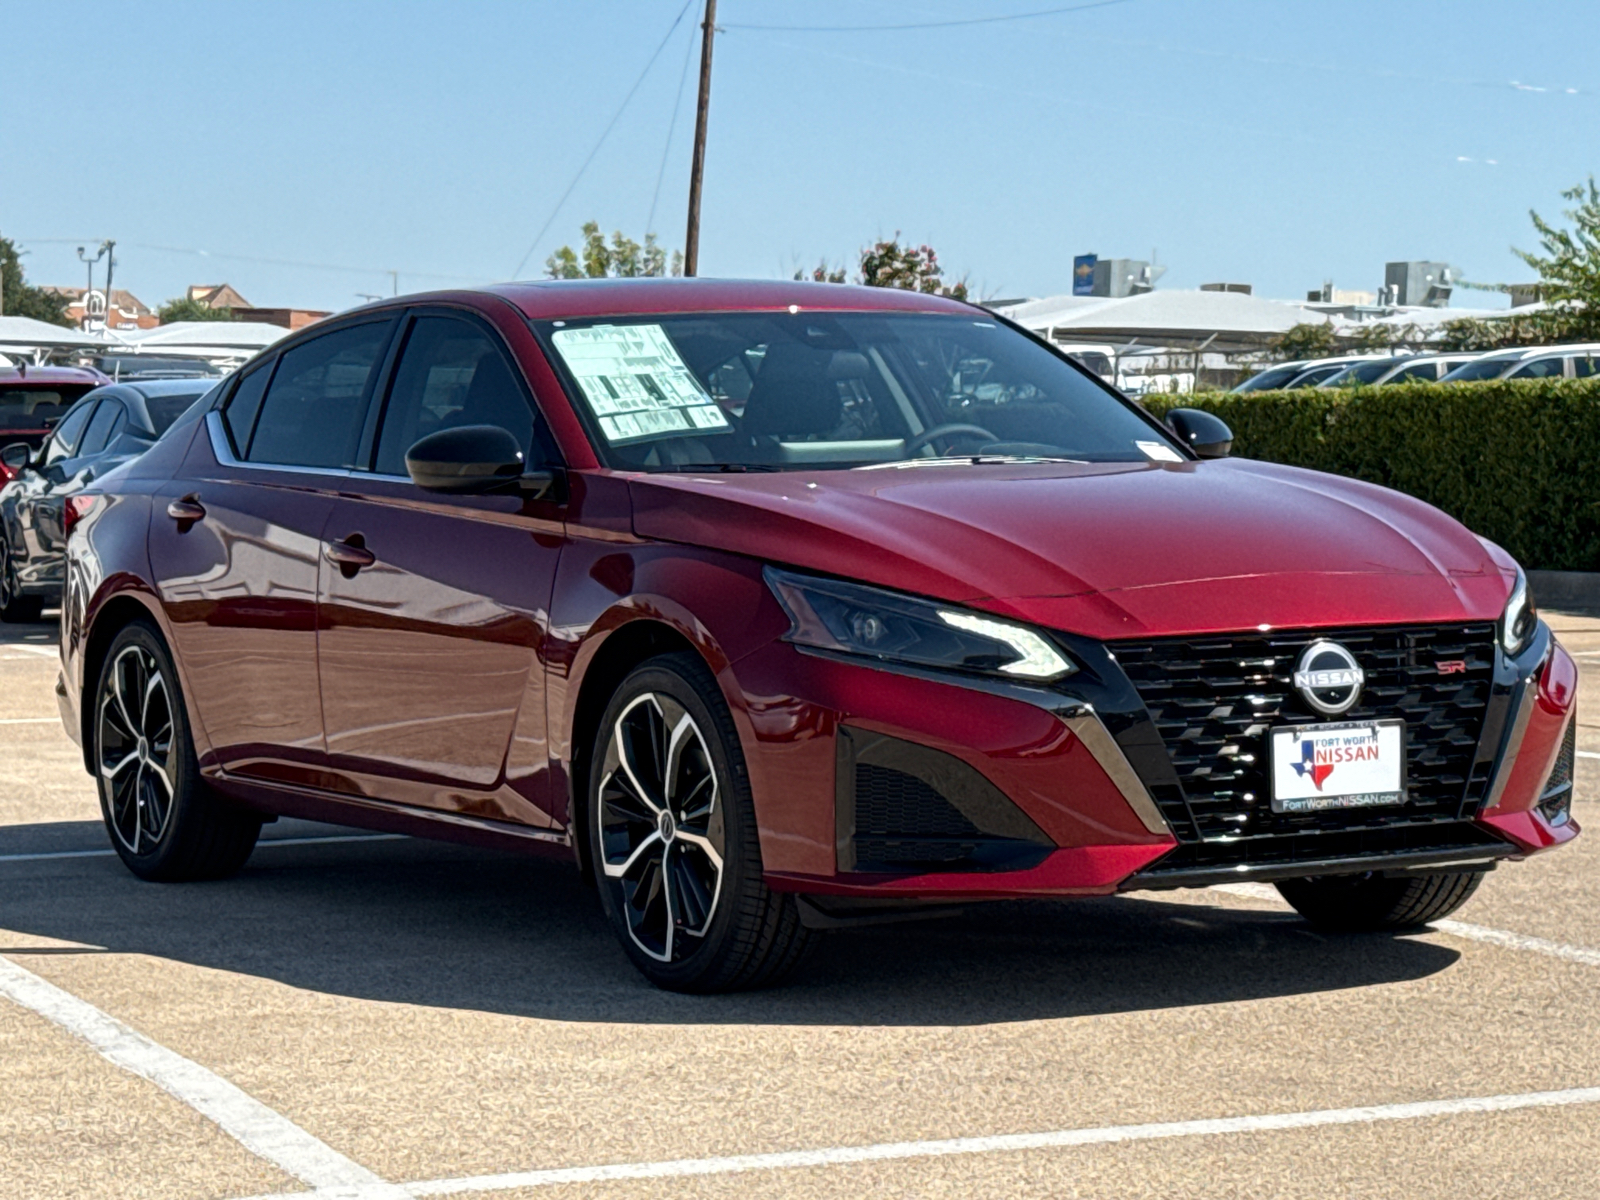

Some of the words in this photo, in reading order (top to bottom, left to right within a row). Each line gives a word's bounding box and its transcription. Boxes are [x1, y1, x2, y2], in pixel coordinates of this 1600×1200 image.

[1435, 660, 1466, 675] SR
[1296, 671, 1363, 686] NISSAN
[1315, 738, 1340, 747] FORT
[1343, 735, 1378, 746] WORTH
[1316, 745, 1379, 763] NISSAN
